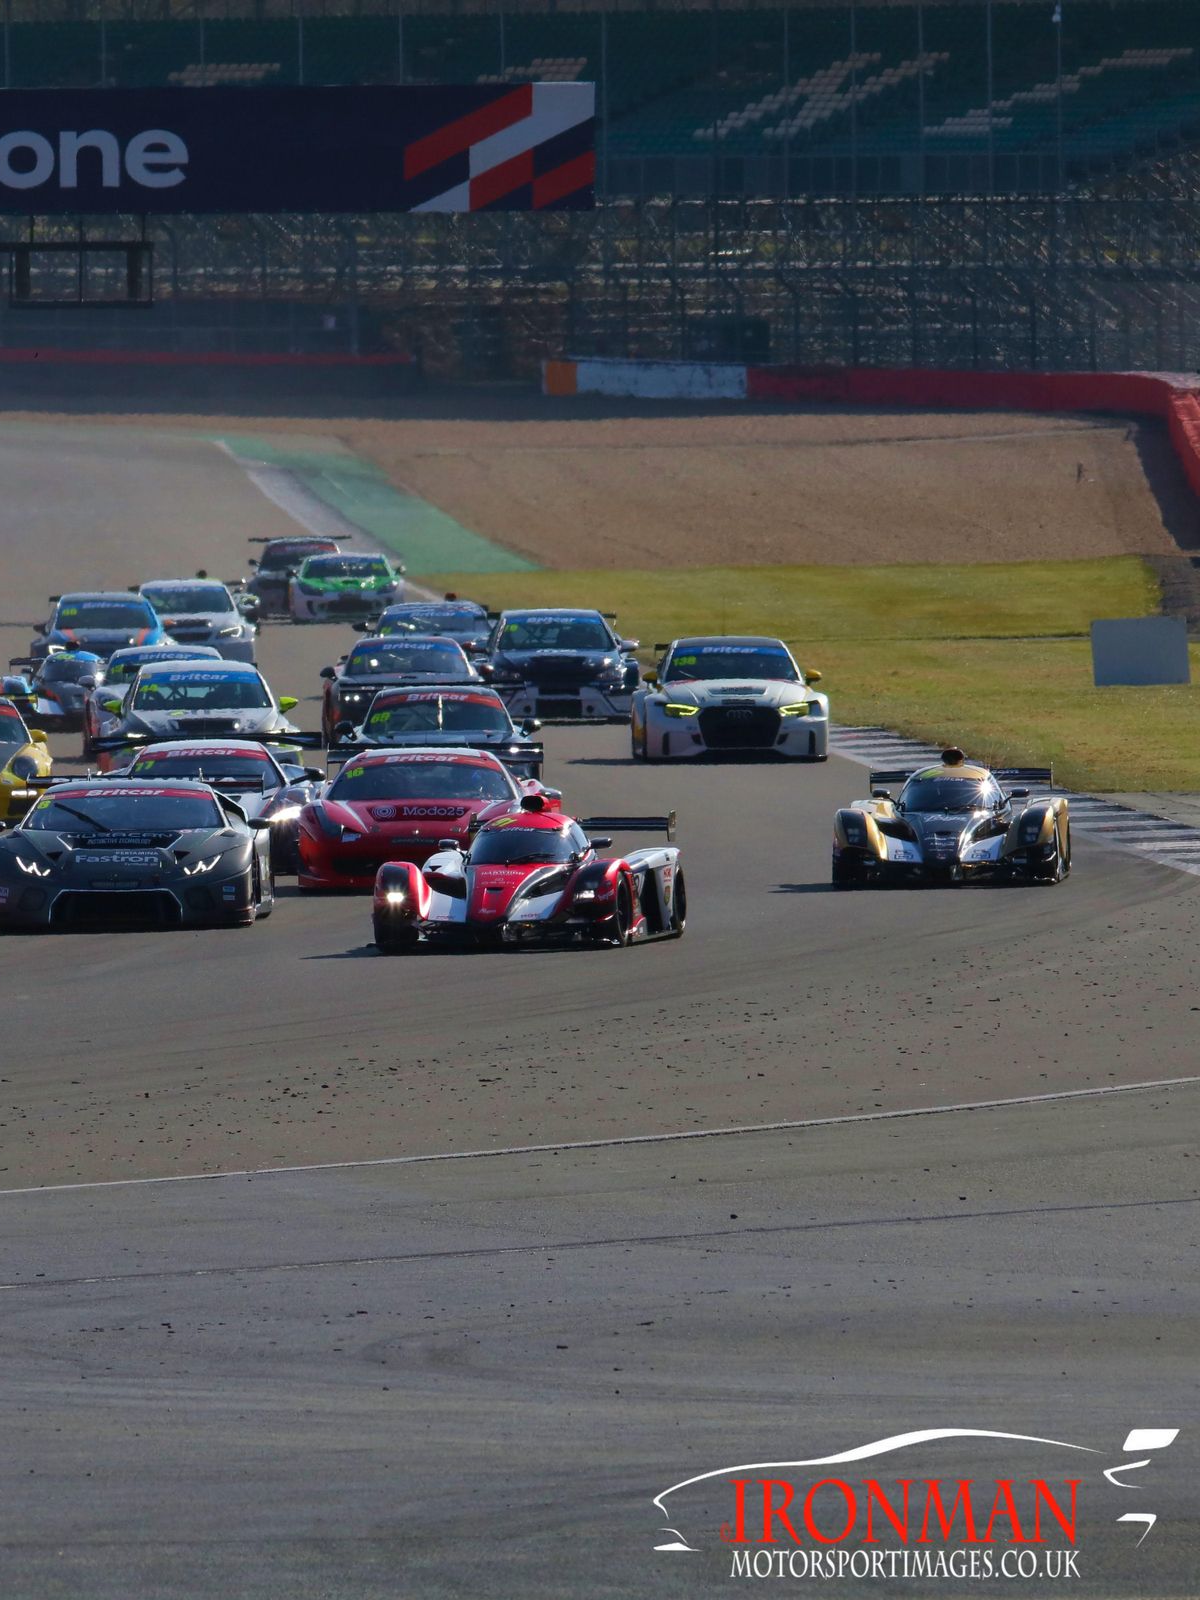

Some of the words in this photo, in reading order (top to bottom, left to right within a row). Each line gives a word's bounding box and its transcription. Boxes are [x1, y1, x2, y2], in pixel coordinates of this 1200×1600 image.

[382, 643, 436, 651] Britcar
[701, 646, 758, 654] Britcar
[138, 652, 193, 661] Britcar
[169, 673, 230, 681] Britcar
[406, 693, 470, 701] Britcar
[166, 748, 237, 758] Britcar
[385, 754, 458, 764] Britcar
[84, 789, 166, 798] Britcar
[402, 806, 465, 817] Modo25
[75, 855, 159, 864] Fastron
